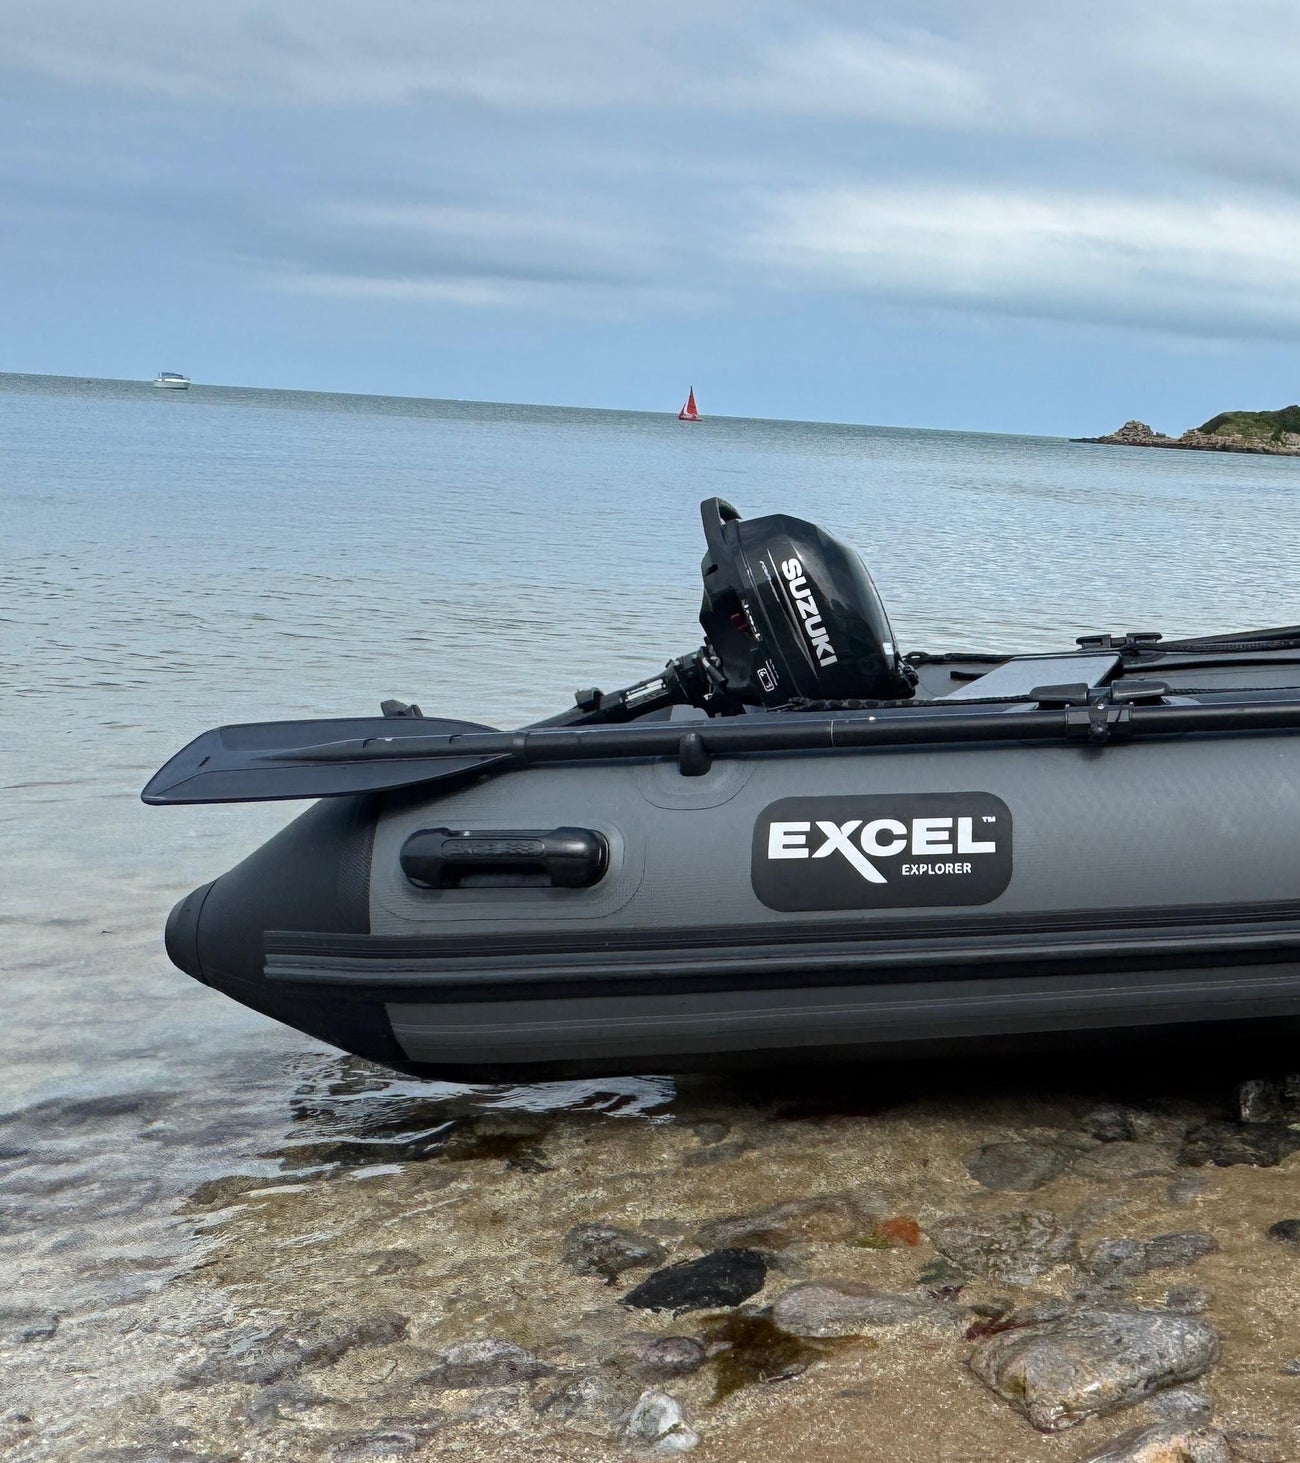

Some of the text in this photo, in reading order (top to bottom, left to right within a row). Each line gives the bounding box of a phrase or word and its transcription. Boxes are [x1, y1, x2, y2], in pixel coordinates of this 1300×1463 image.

[781, 559, 838, 667] SUZUKI
[768, 816, 996, 883] EXCEL
[902, 862, 972, 875] EXPLORER
